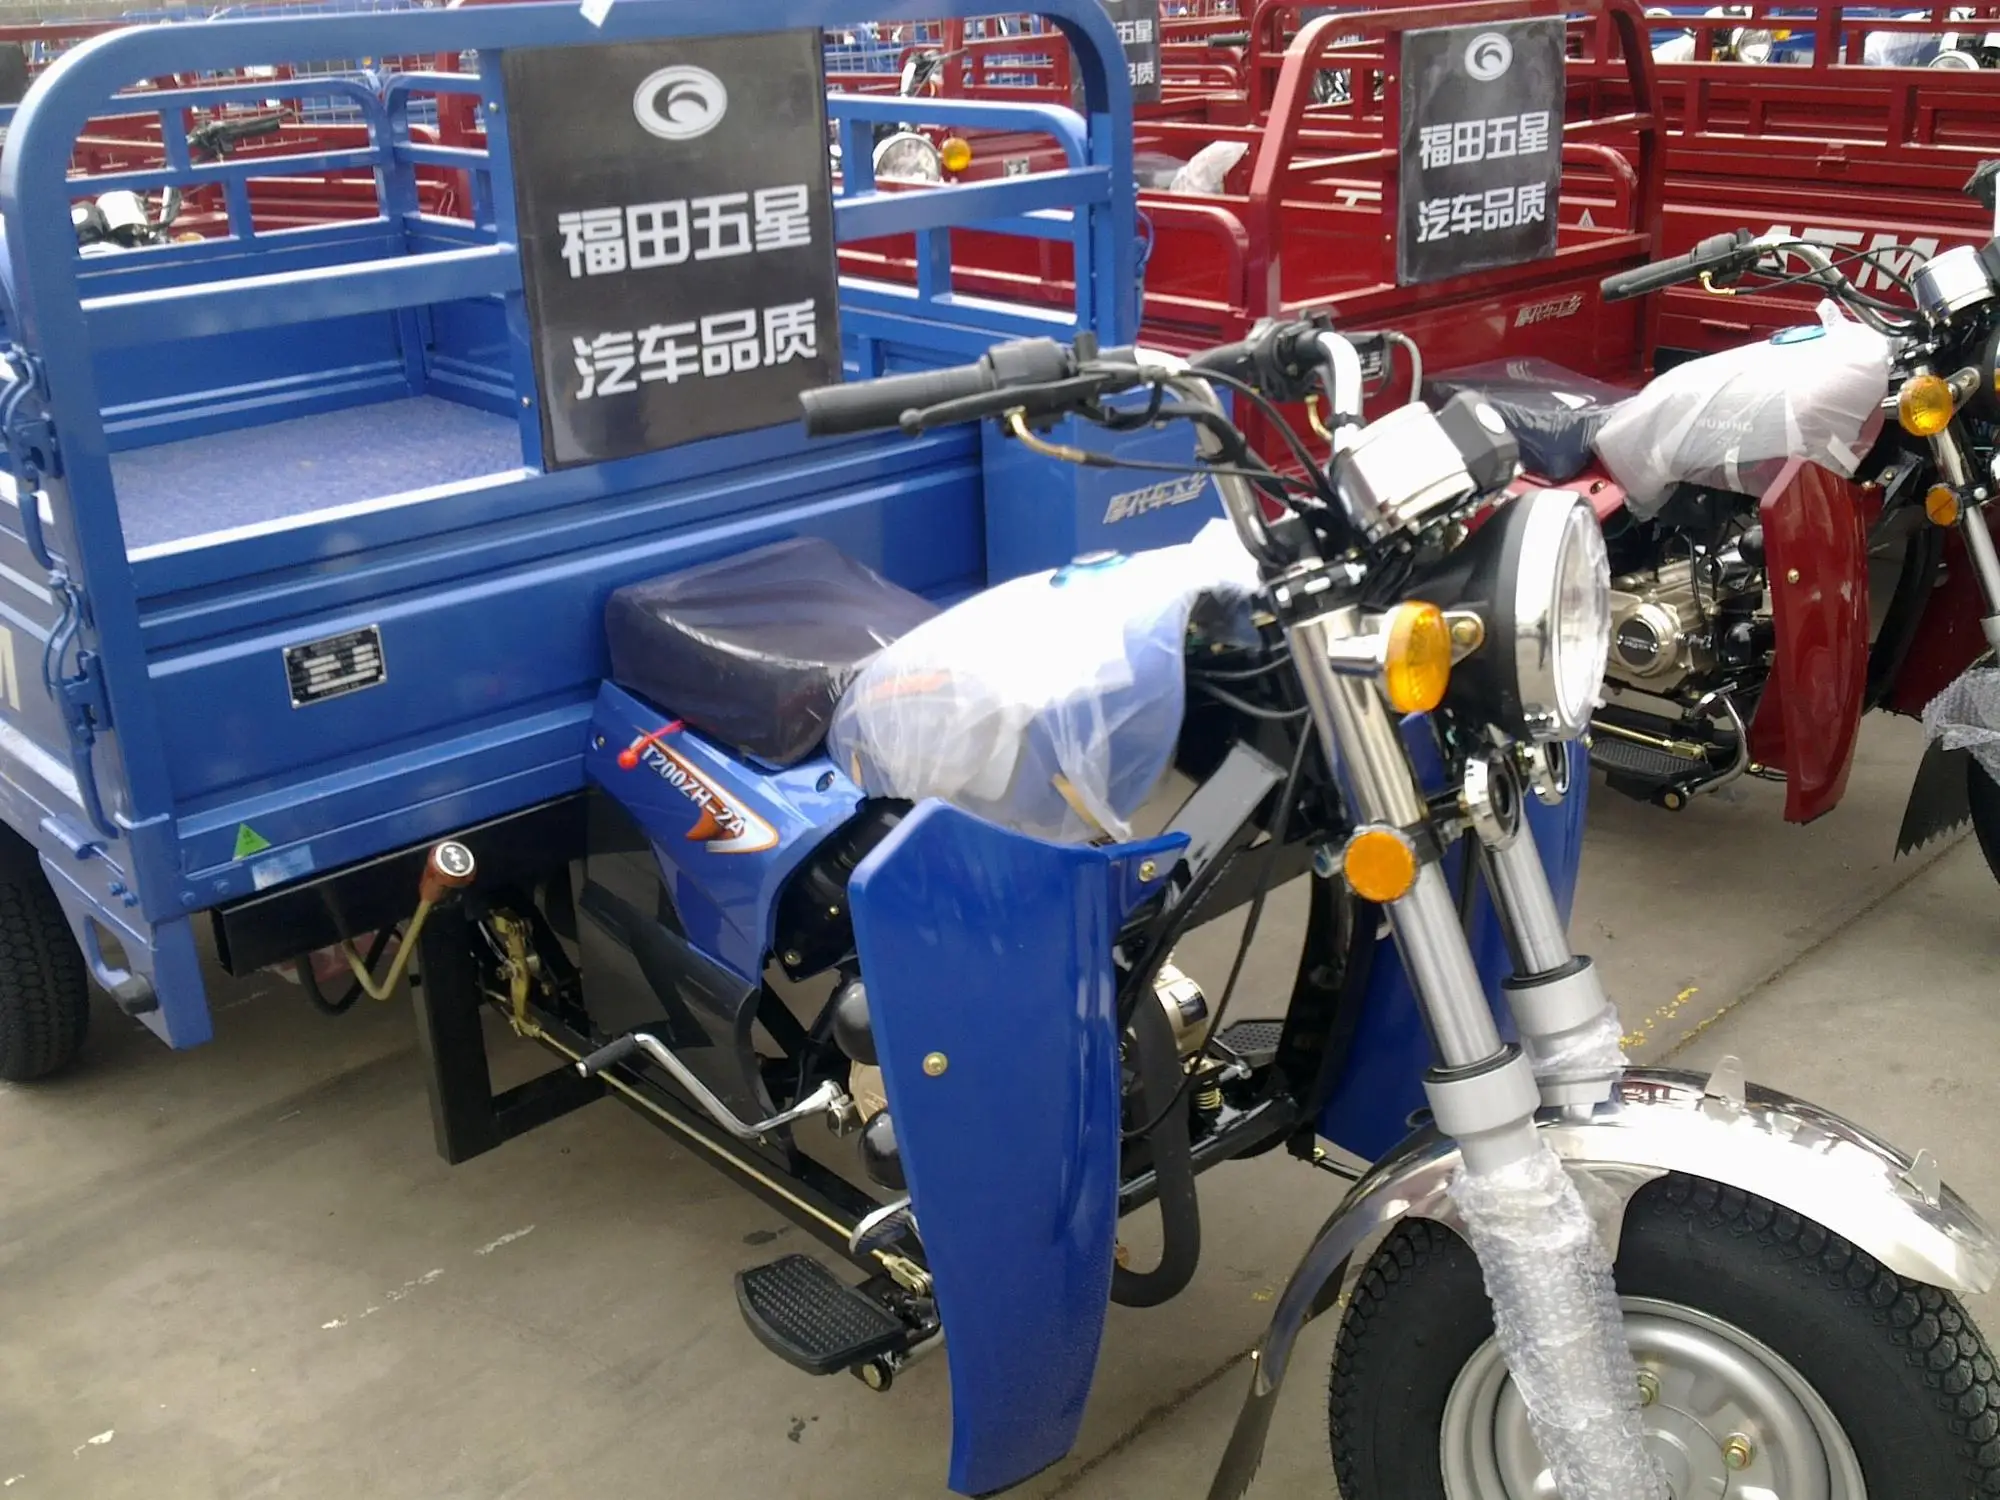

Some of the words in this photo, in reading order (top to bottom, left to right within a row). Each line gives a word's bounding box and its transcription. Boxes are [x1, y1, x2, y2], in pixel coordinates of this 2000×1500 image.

[1113, 19, 1153, 44] 五星
[1419, 111, 1550, 170] 福田五星
[558, 184, 812, 278] 福田五星
[1416, 181, 1547, 242] 汽车品质
[572, 298, 818, 400] 汽车品质
